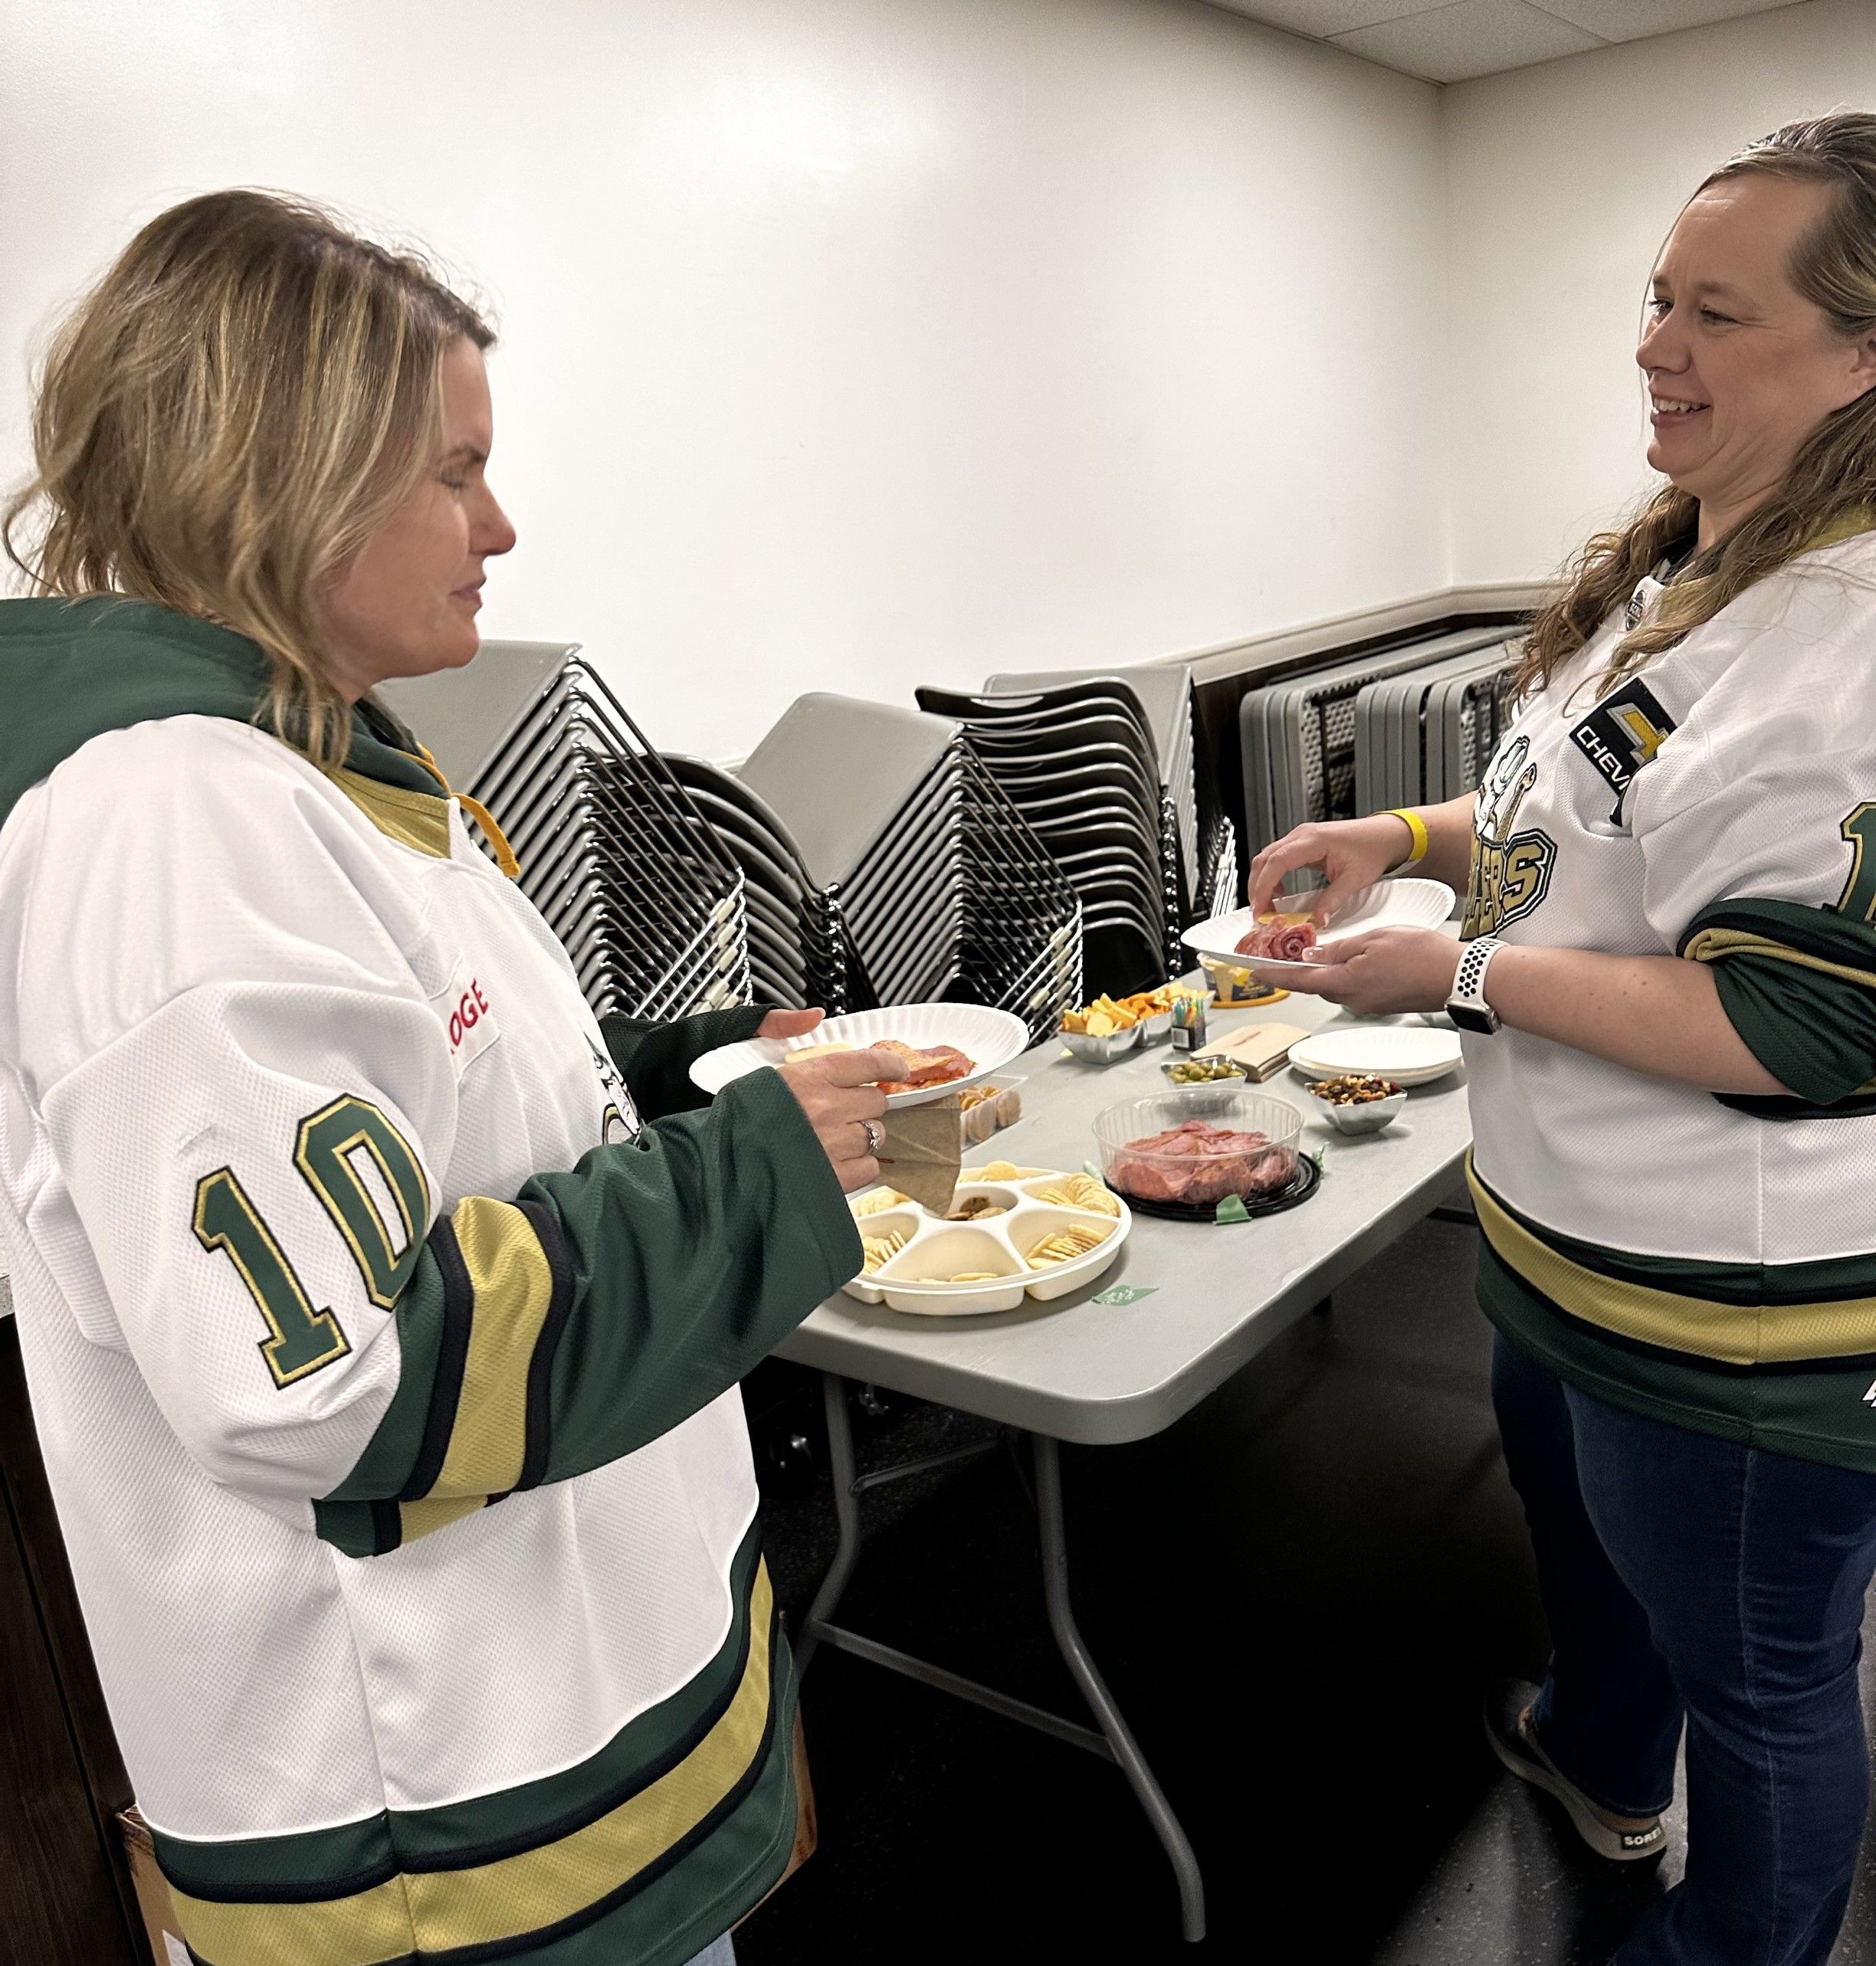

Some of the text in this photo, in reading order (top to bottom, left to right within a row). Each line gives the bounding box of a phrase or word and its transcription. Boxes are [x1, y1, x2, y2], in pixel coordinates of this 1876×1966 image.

[1576, 725, 1631, 791] CHEV
[449, 977, 489, 1055] OGE
[192, 1093, 430, 1390] 10
